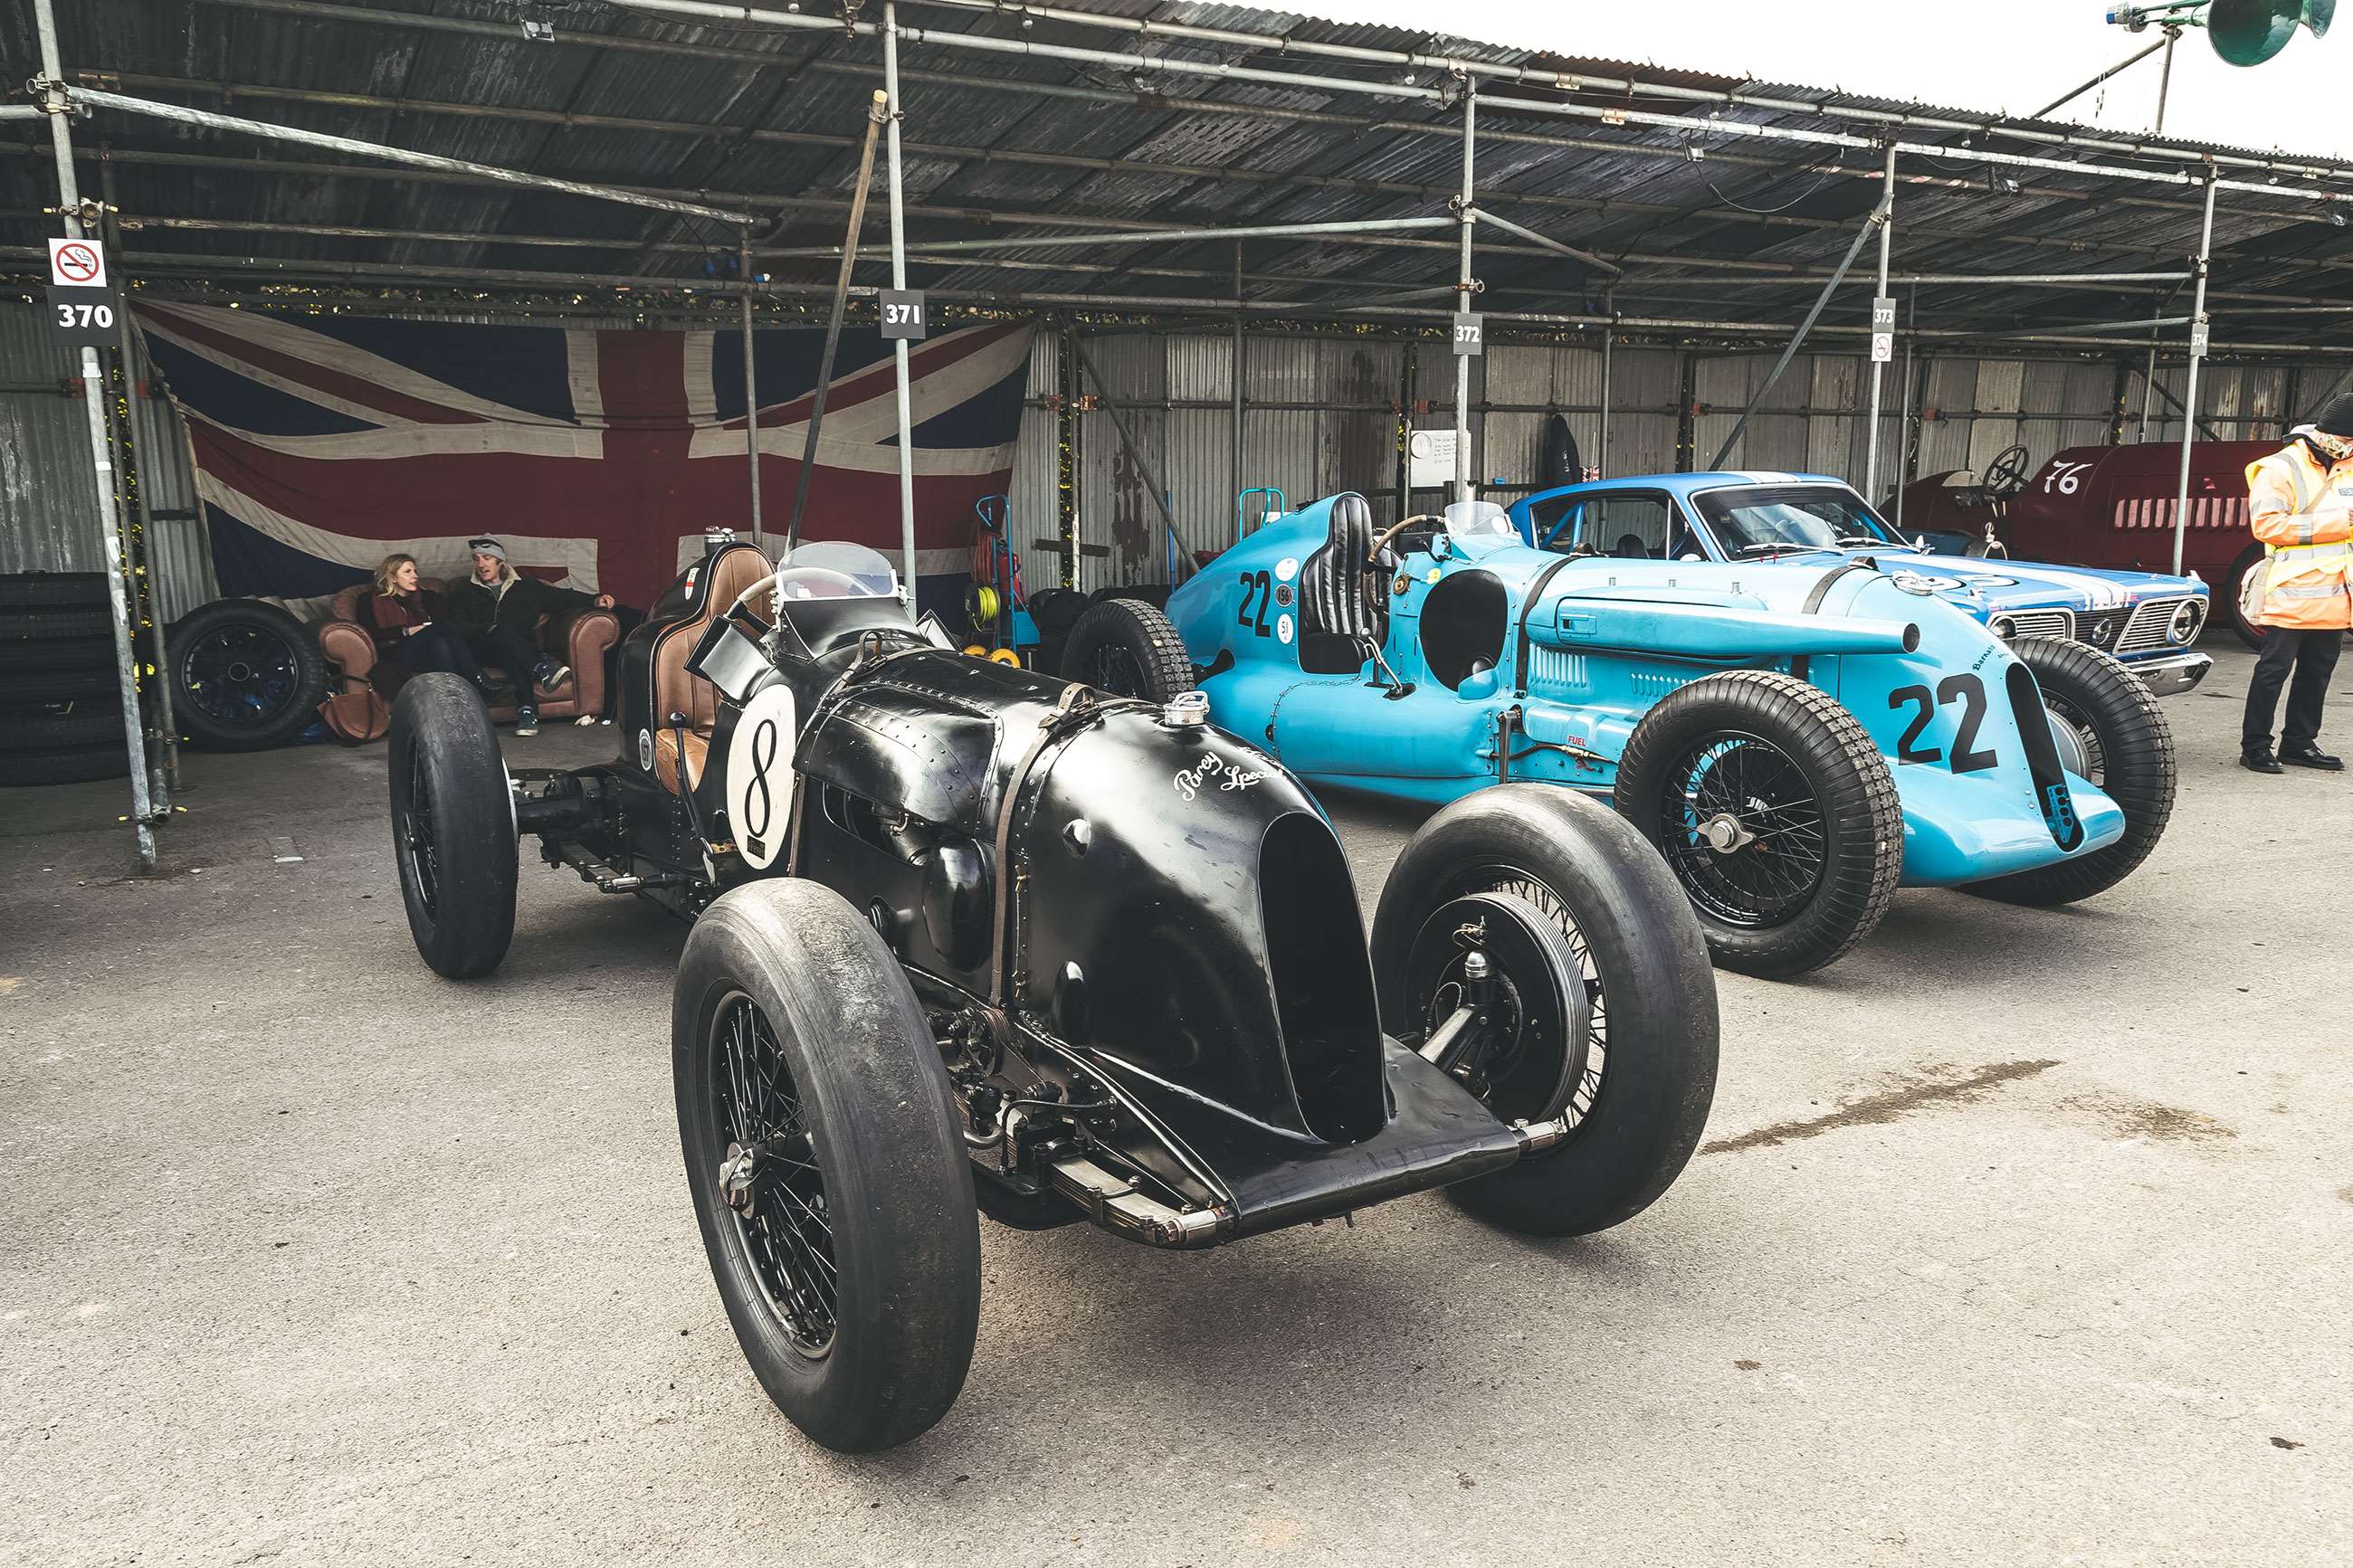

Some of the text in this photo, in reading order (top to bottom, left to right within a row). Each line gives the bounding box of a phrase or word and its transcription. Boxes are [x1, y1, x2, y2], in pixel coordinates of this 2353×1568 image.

[57, 303, 114, 328] 370
[886, 303, 920, 325] 371
[1874, 308, 1893, 324] 373
[1455, 325, 1480, 343] 372
[2044, 460, 2093, 495] 76
[1237, 569, 1272, 638] 22
[1888, 672, 1998, 774] 22
[1567, 735, 1586, 747] FUEL
[744, 718, 777, 838] 8
